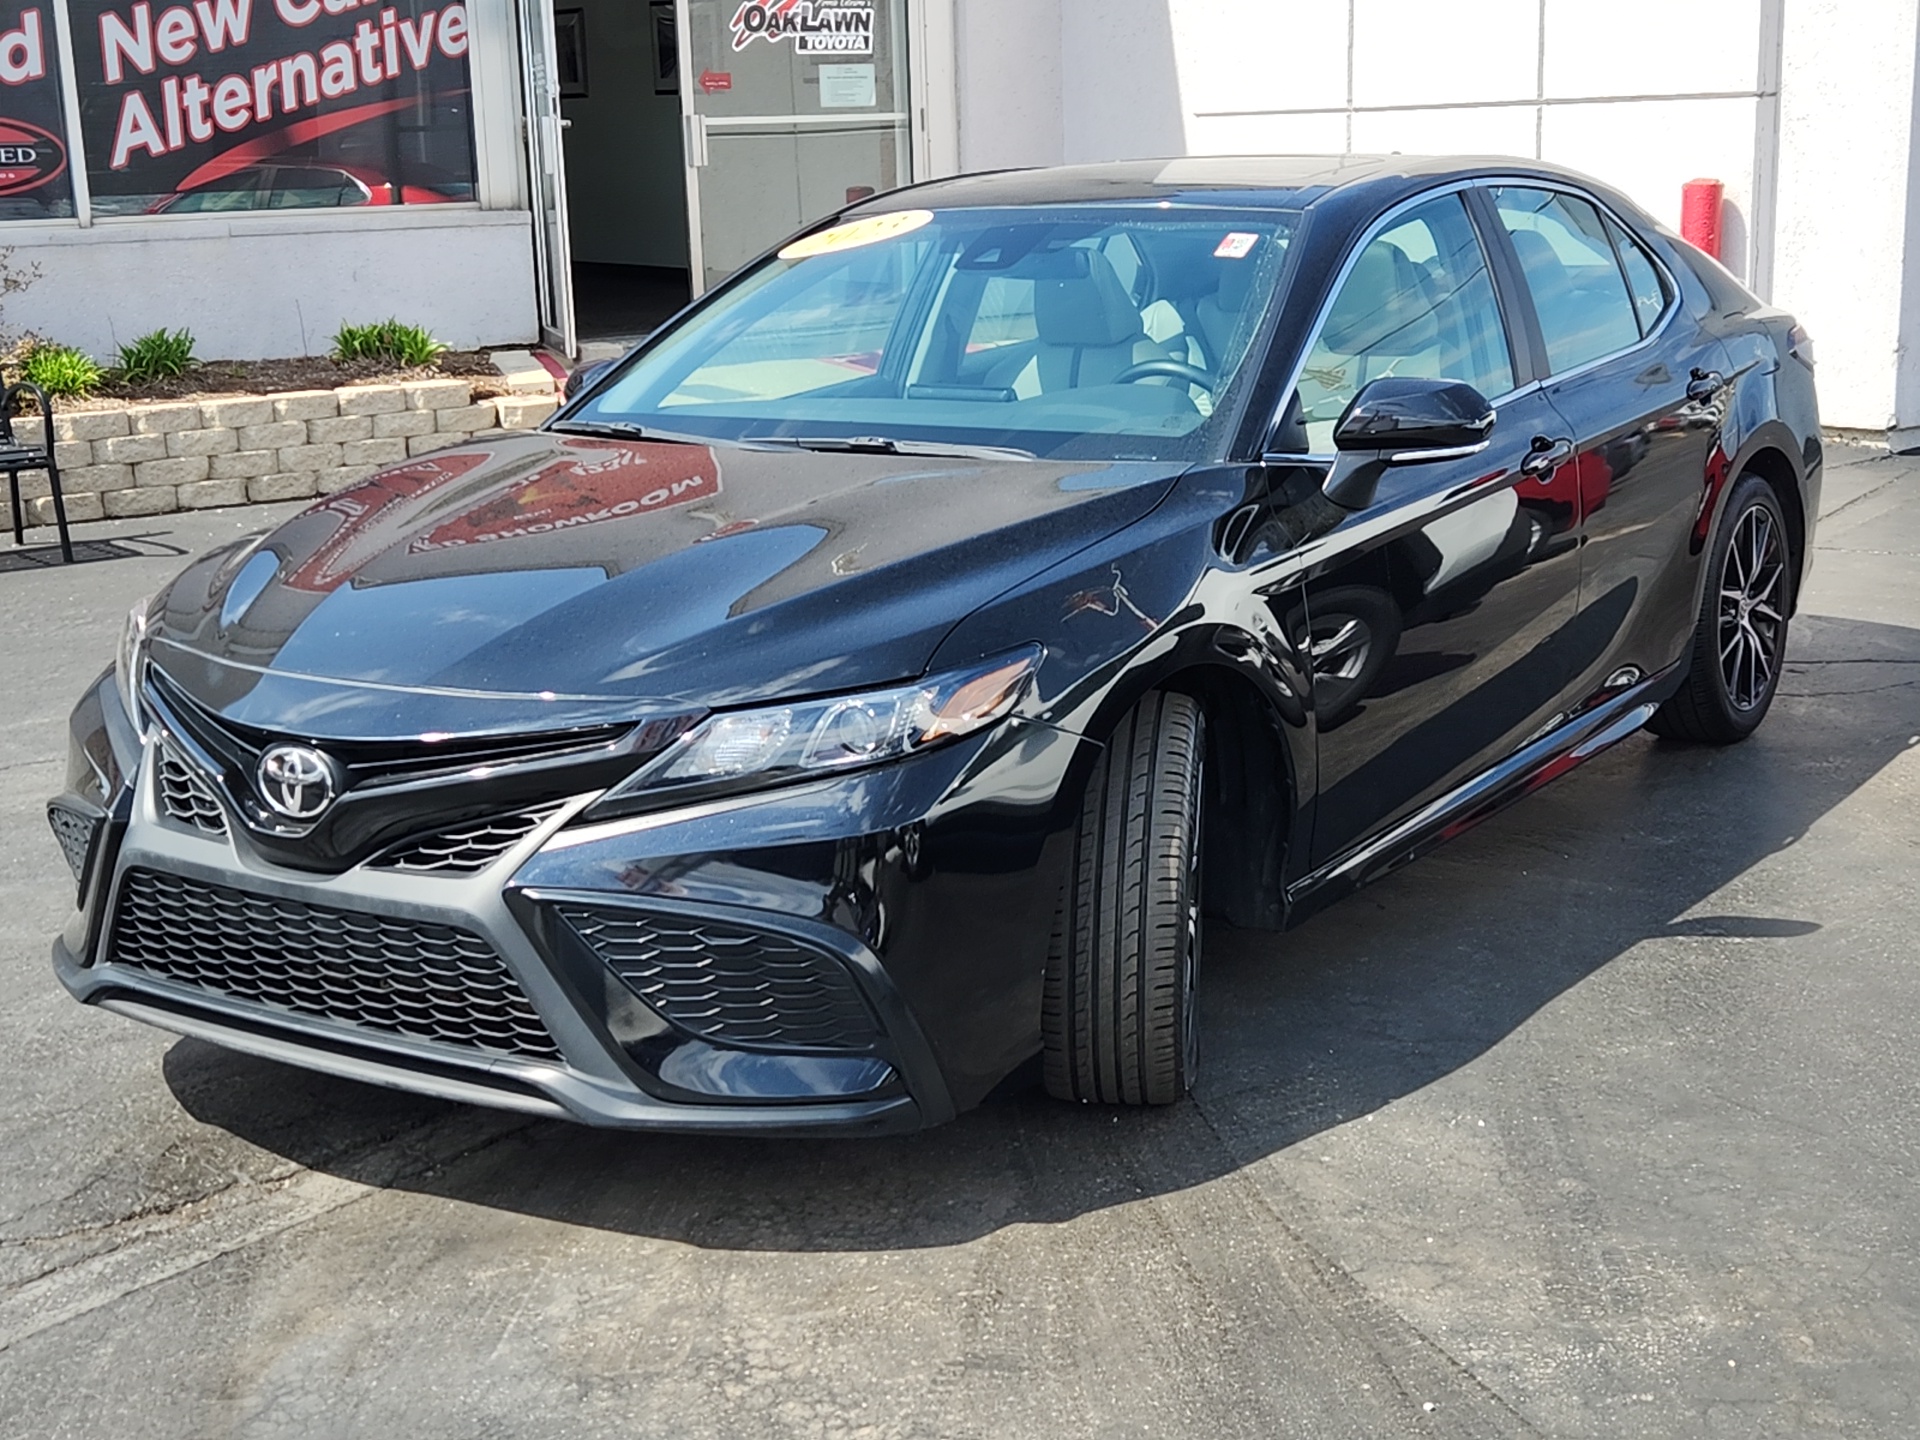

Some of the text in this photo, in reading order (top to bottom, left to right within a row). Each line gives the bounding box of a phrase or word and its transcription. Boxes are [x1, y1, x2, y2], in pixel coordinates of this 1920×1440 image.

[101, 0, 250, 83] New
[804, 34, 867, 50] TOYOTA
[111, 5, 470, 169] Alternative
